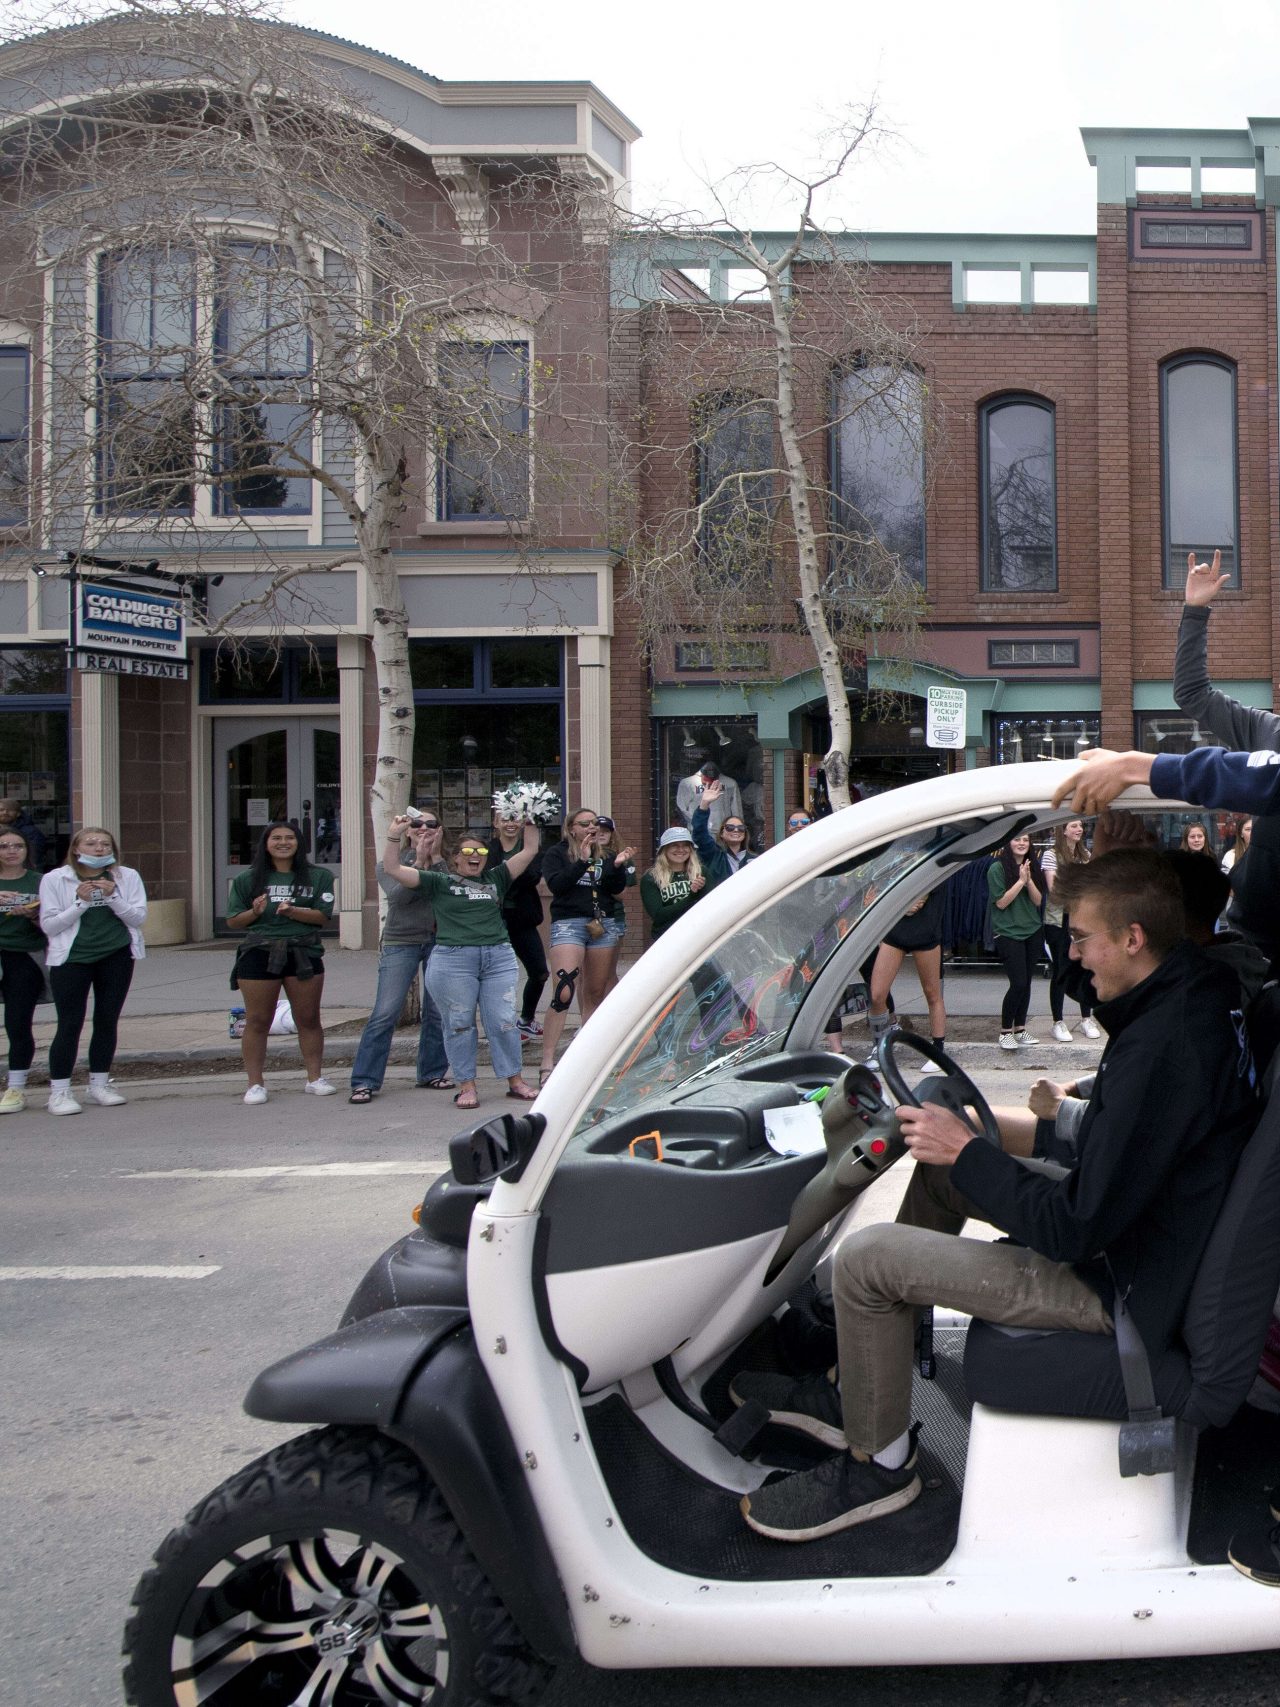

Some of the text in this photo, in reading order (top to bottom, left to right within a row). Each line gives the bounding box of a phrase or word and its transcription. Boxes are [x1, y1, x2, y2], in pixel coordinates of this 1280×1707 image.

[87, 594, 178, 619] COLDWELL
[89, 606, 163, 629] BANKER
[87, 633, 177, 652] MOUNTAIN PROPERTIES
[86, 655, 184, 678] REAL ESTATE
[930, 689, 941, 699] 10
[320, 1632, 346, 1652] SS
